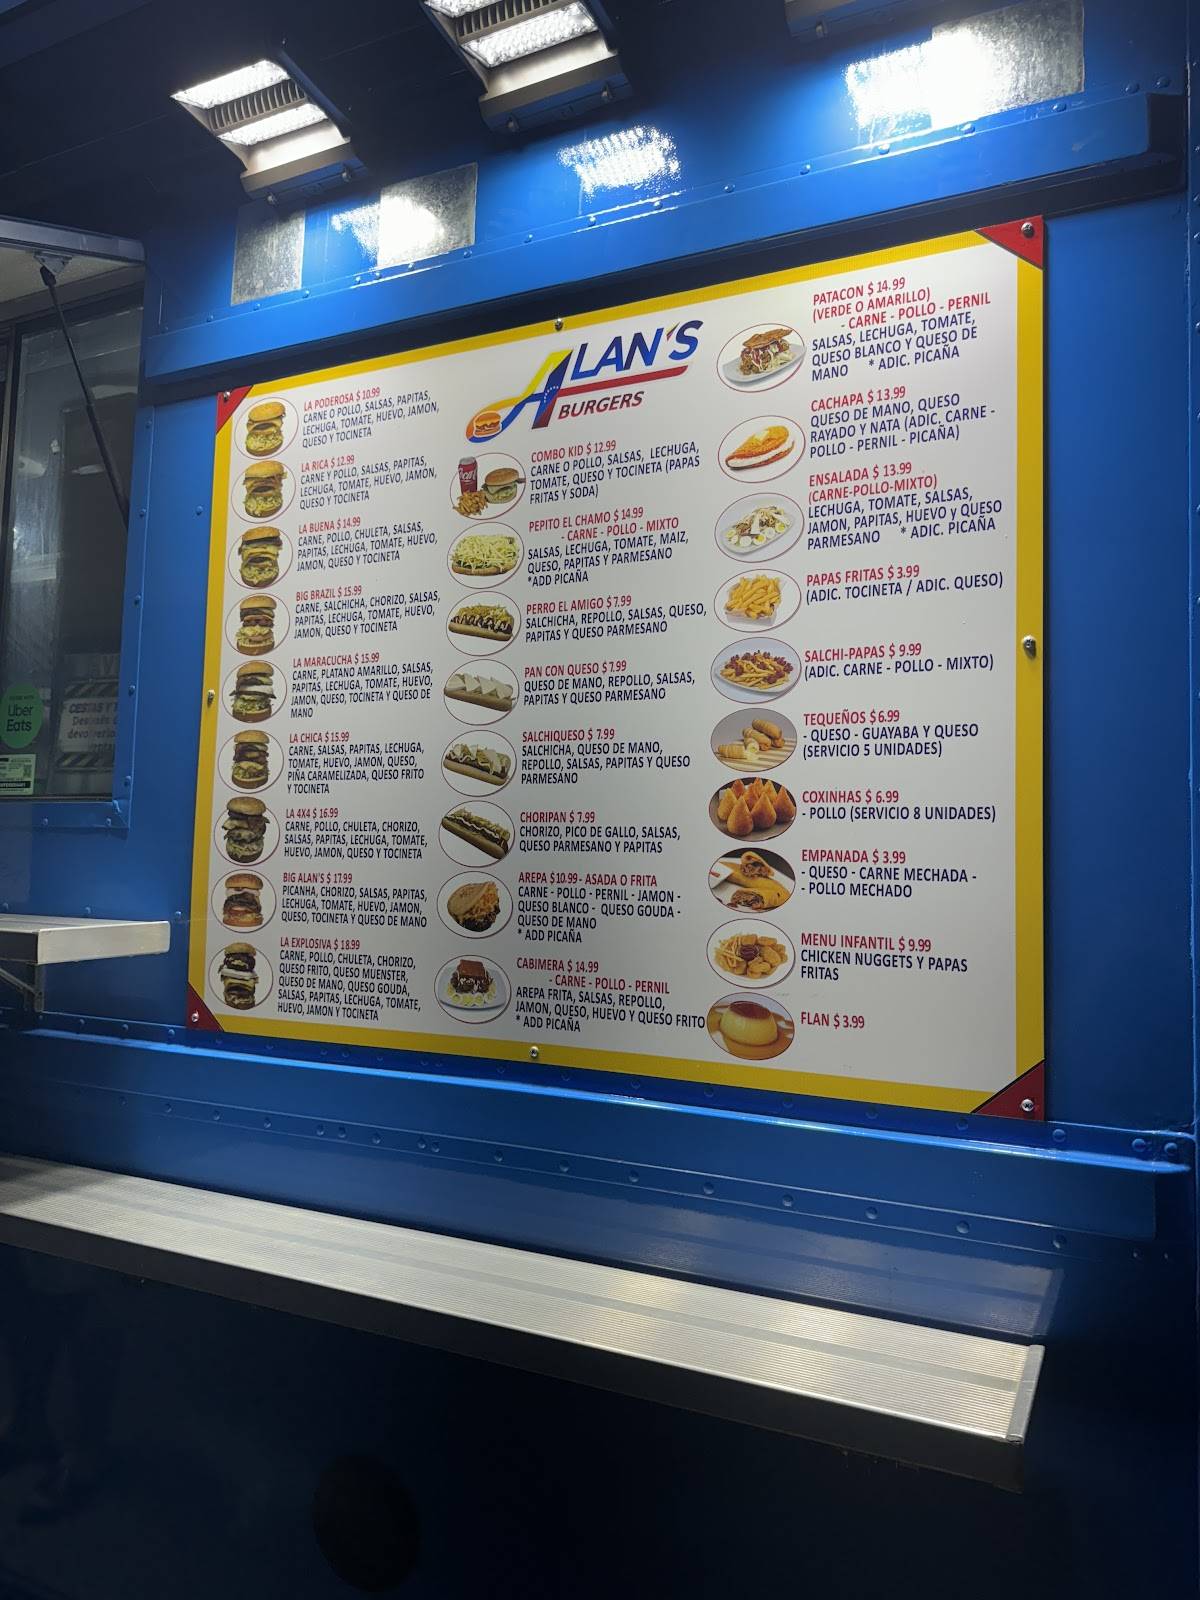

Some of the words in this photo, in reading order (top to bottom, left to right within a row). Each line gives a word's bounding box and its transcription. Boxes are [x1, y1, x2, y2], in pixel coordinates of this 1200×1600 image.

[813, 285, 863, 306] PATACON
[813, 303, 851, 324] (VERDE
[867, 287, 930, 311] AMARILLO)
[812, 332, 855, 351] SALSAS,
[860, 322, 917, 343] LECHUGA,
[921, 311, 975, 332] TOMATE,
[466, 320, 703, 443] ALAN'S
[304, 401, 312, 412] LA
[315, 393, 354, 409] PODEROSA
[557, 391, 645, 419] BURGERS
[810, 410, 850, 428] QUESO
[853, 407, 868, 421] DE
[872, 401, 914, 418] MANO,
[918, 393, 960, 412] QUESO
[811, 392, 864, 412] CACHAPA
[531, 447, 566, 463] COMBO
[568, 445, 584, 458] KID
[530, 475, 570, 491] TOMATE,
[572, 469, 605, 486] QUESO
[615, 461, 663, 479] TOCINETA
[665, 455, 700, 474] (PAPAS
[809, 467, 869, 487] ENSALADA
[808, 500, 865, 519] LECHUGA,
[868, 493, 921, 511] TOMATE,
[925, 486, 973, 505] SALSAS,
[529, 518, 560, 533] PEPITO
[562, 516, 573, 528] EL
[575, 511, 611, 526] CHAMO
[527, 545, 563, 562] SALSAS,
[565, 540, 611, 556] LECHUGA,
[613, 534, 657, 550] TOMATE,
[660, 530, 689, 545] MAIZ,
[807, 571, 841, 587] PAPAS
[845, 567, 884, 583] FRITAS
[296, 591, 308, 602] BIG
[310, 588, 336, 600] BRAZIL
[806, 588, 841, 605] (ADIC.
[844, 582, 902, 599] TOCINETA
[916, 577, 950, 593] ADIC.
[954, 571, 1003, 591] QUESO)
[526, 602, 556, 615] PERRO
[558, 601, 568, 613] EL
[570, 597, 604, 611] AMIGO
[525, 614, 578, 630] SALCHICHA,
[581, 609, 625, 625] REPOLLO,
[627, 606, 666, 621] SALSAS,
[668, 603, 707, 618] QUESO,
[293, 658, 302, 668] LA
[303, 654, 352, 667] MARACUCHA
[804, 645, 885, 663] SALCHI-PAPAS
[8, 704, 34, 717] Uber
[803, 708, 866, 727] TEQUEÑOS
[6, 718, 33, 732] Eats
[522, 729, 585, 745] SALCHIQUESO
[803, 743, 860, 761] (SERVICIO
[874, 740, 942, 758] UNIDADES)
[521, 758, 564, 774] REPOLLO,
[566, 757, 603, 772] SALSAS,
[605, 756, 644, 769] PAPITAS
[655, 755, 691, 770] QUESO
[287, 768, 306, 781] PIÑA
[371, 768, 399, 781] QUESO
[401, 768, 425, 780] FRITO
[521, 771, 578, 785] PARMESANO
[802, 790, 861, 804] COXINHAS
[519, 839, 552, 853] QUESO
[553, 839, 612, 853] PARMESANO
[623, 841, 663, 854] PAPITAS
[802, 849, 869, 863] EMPANADA
[283, 872, 296, 883] BIG
[297, 872, 325, 884] ALAN'S
[517, 914, 550, 930] QUESO
[551, 915, 564, 928] DE
[566, 915, 597, 930] MANO
[280, 936, 290, 947] LA
[291, 937, 332, 950] EXPLOSIVA
[801, 932, 837, 947] MENU
[841, 935, 895, 951] INFANTIL
[516, 957, 565, 972] CABIMERA
[801, 949, 851, 965] CHICKEN
[855, 952, 913, 969] NUGGETS
[928, 956, 968, 972] PAPAS
[279, 962, 306, 976] QUESO
[332, 966, 360, 981] QUESO
[801, 965, 839, 981] FRITAS
[801, 1011, 830, 1027] FLAN
